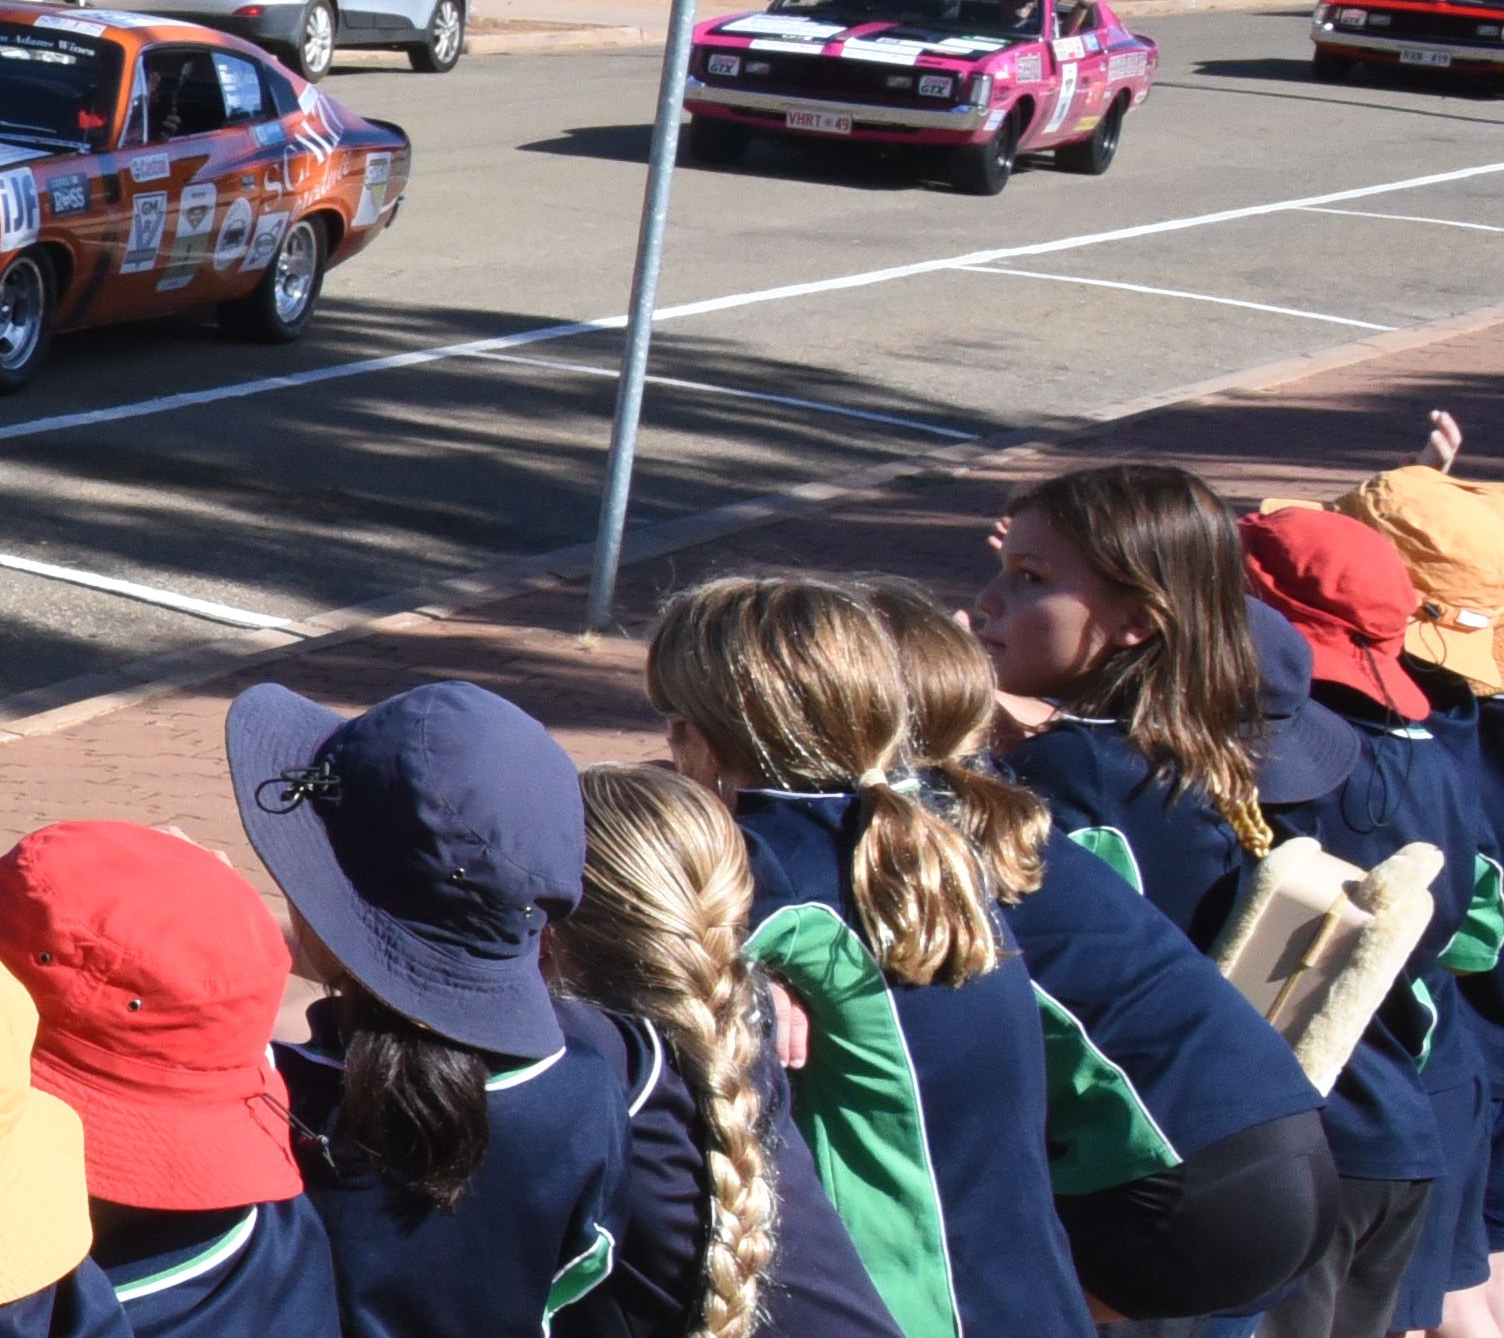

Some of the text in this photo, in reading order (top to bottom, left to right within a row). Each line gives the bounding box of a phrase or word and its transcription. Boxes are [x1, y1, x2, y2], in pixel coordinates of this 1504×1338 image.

[14, 33, 54, 48] Adams
[59, 39, 96, 57] Wines
[921, 85, 946, 95] GTX
[788, 112, 851, 132] VHRT 49
